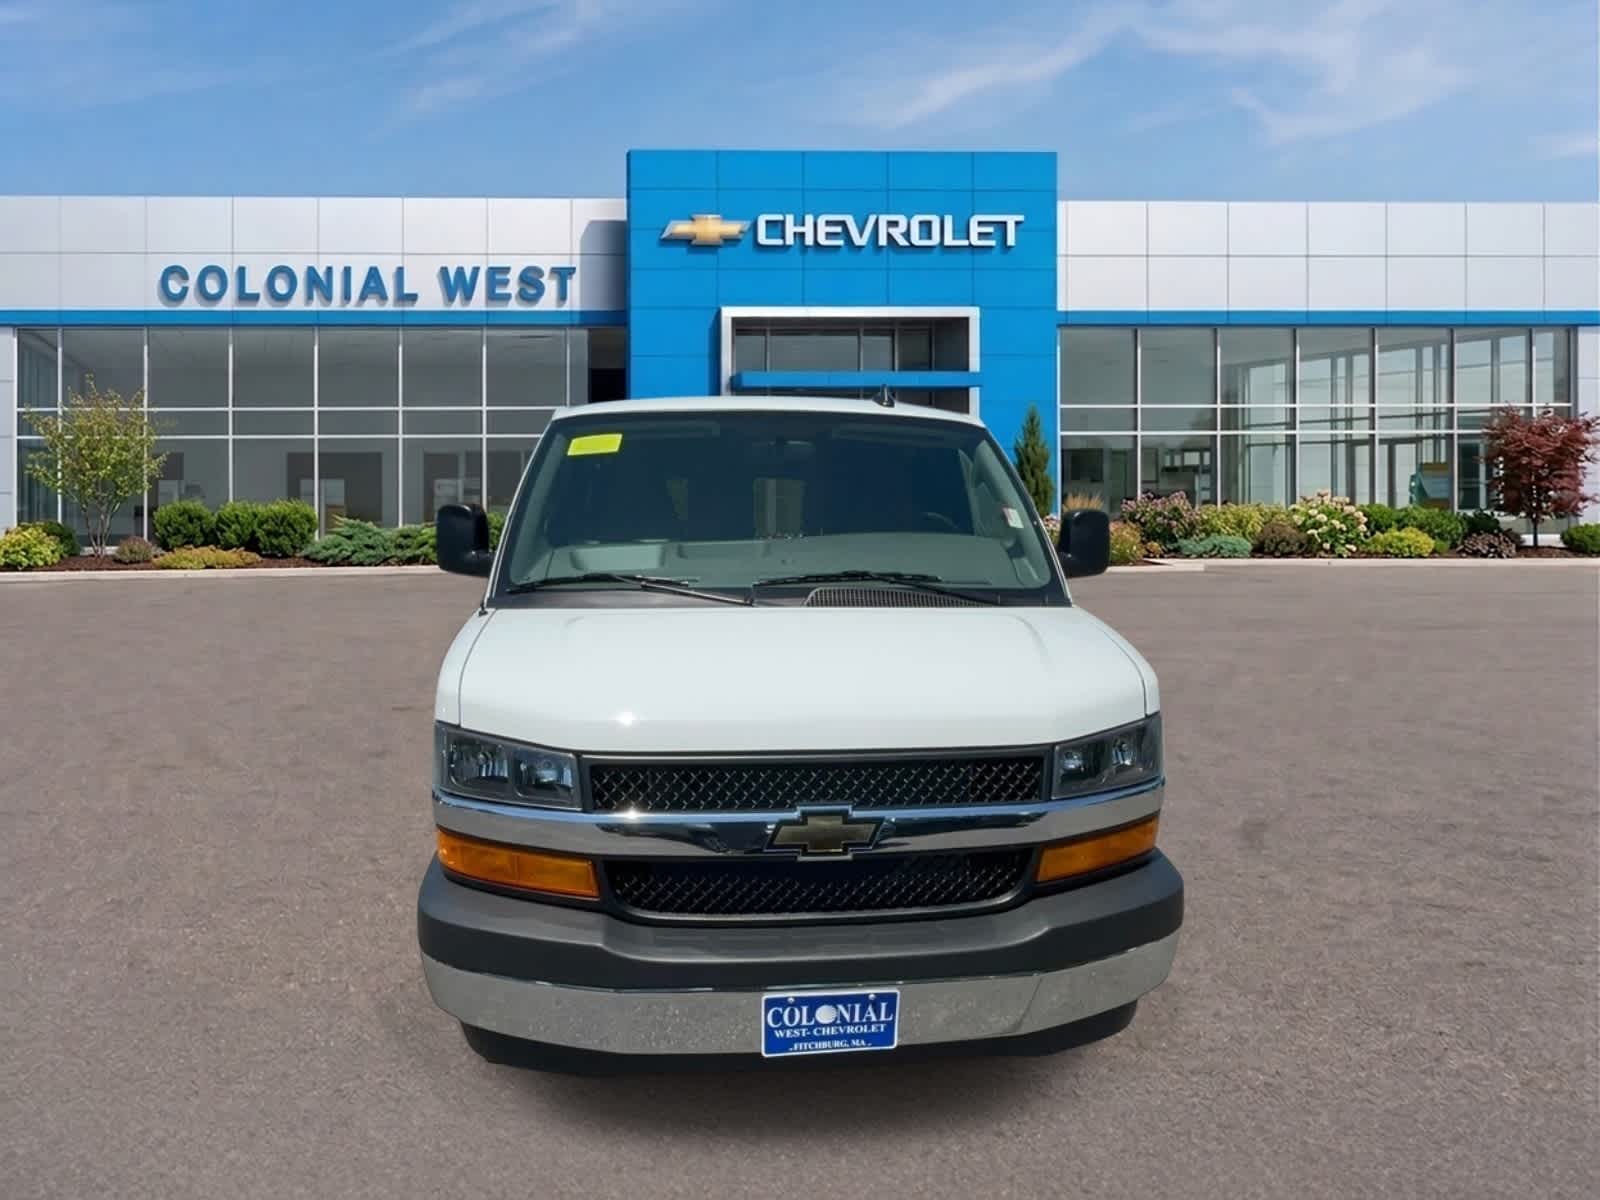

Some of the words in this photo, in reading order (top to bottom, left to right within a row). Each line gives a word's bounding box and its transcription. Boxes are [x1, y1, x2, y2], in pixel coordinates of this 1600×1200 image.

[757, 213, 1025, 247] CHEVROLET
[160, 264, 419, 305] COLONIAL
[438, 265, 577, 305] WEST
[766, 1002, 894, 1028] COLONIAL
[813, 1023, 887, 1036] CHEVROLET
